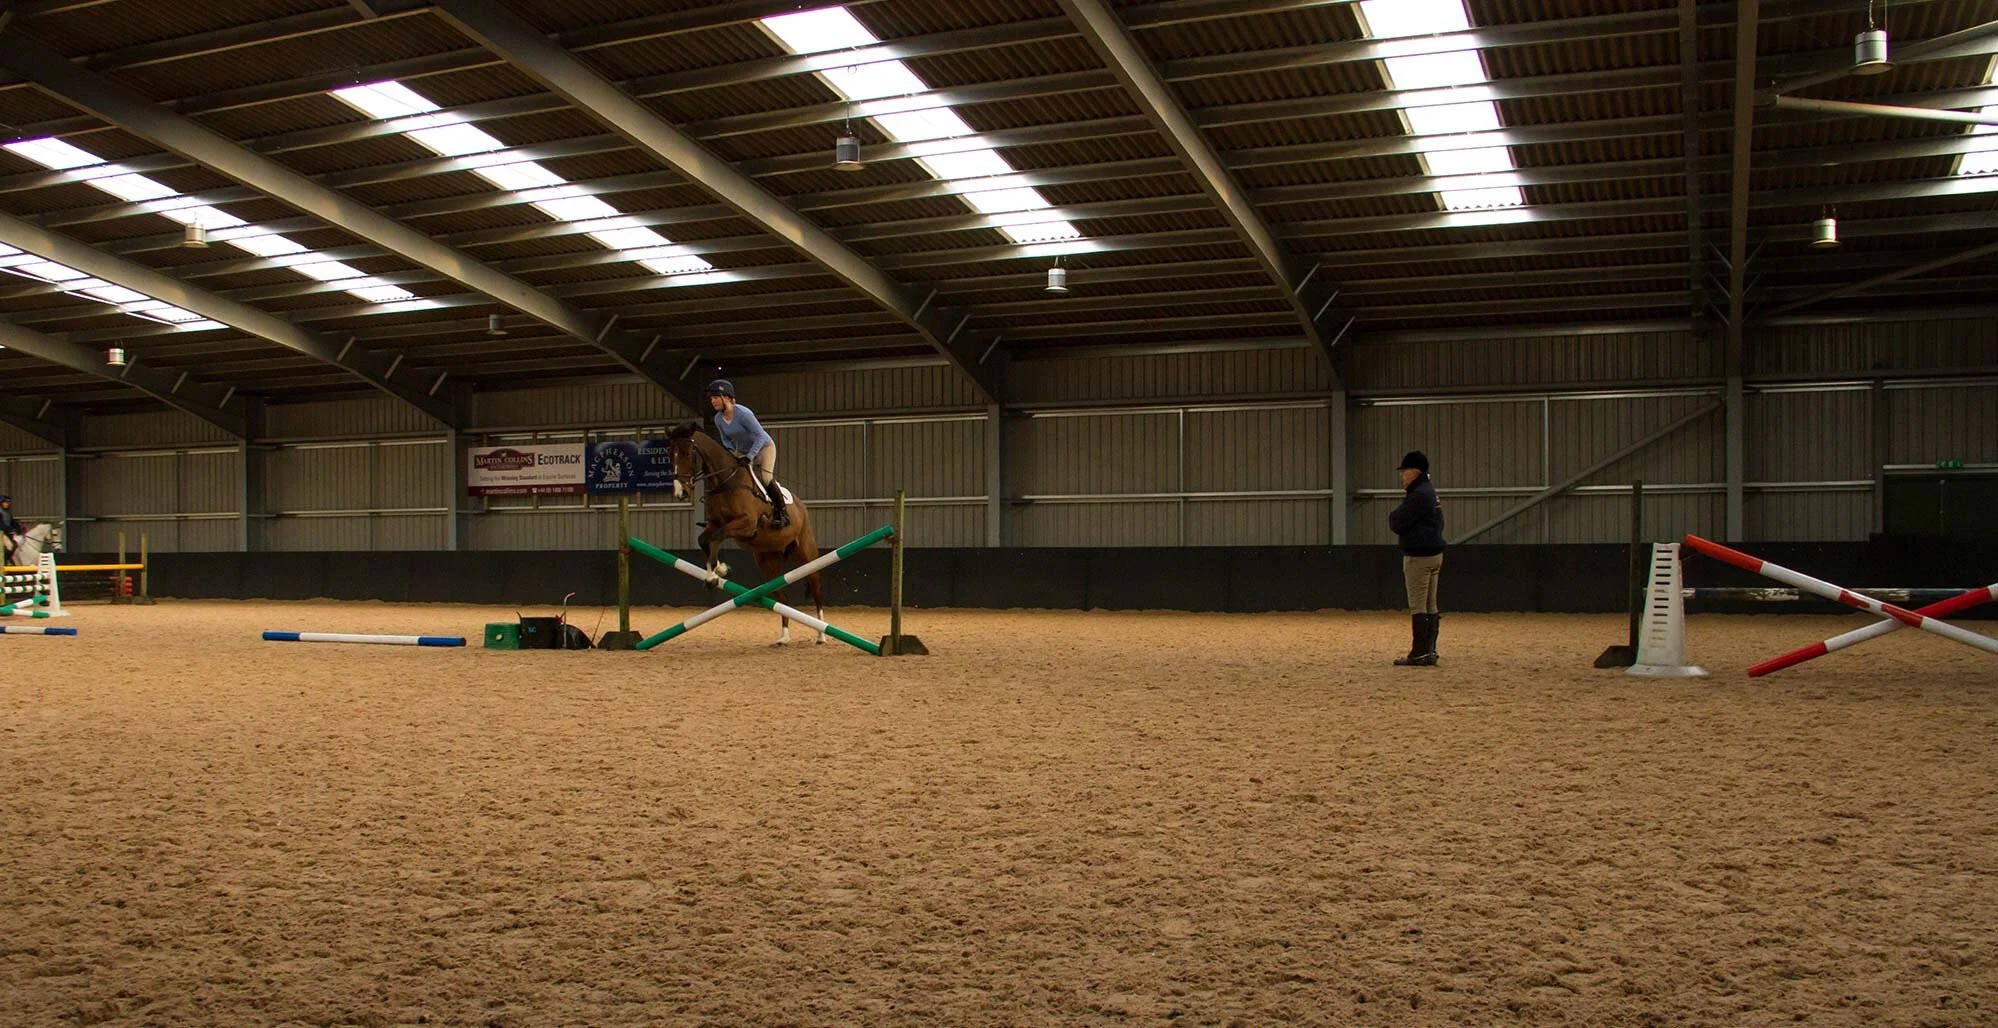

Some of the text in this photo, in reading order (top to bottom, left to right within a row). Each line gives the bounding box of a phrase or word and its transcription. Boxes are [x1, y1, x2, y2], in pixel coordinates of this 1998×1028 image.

[504, 454, 533, 465] COLLINS
[538, 454, 581, 465] ECOTRACK
[587, 447, 635, 478] MACPHERSON
